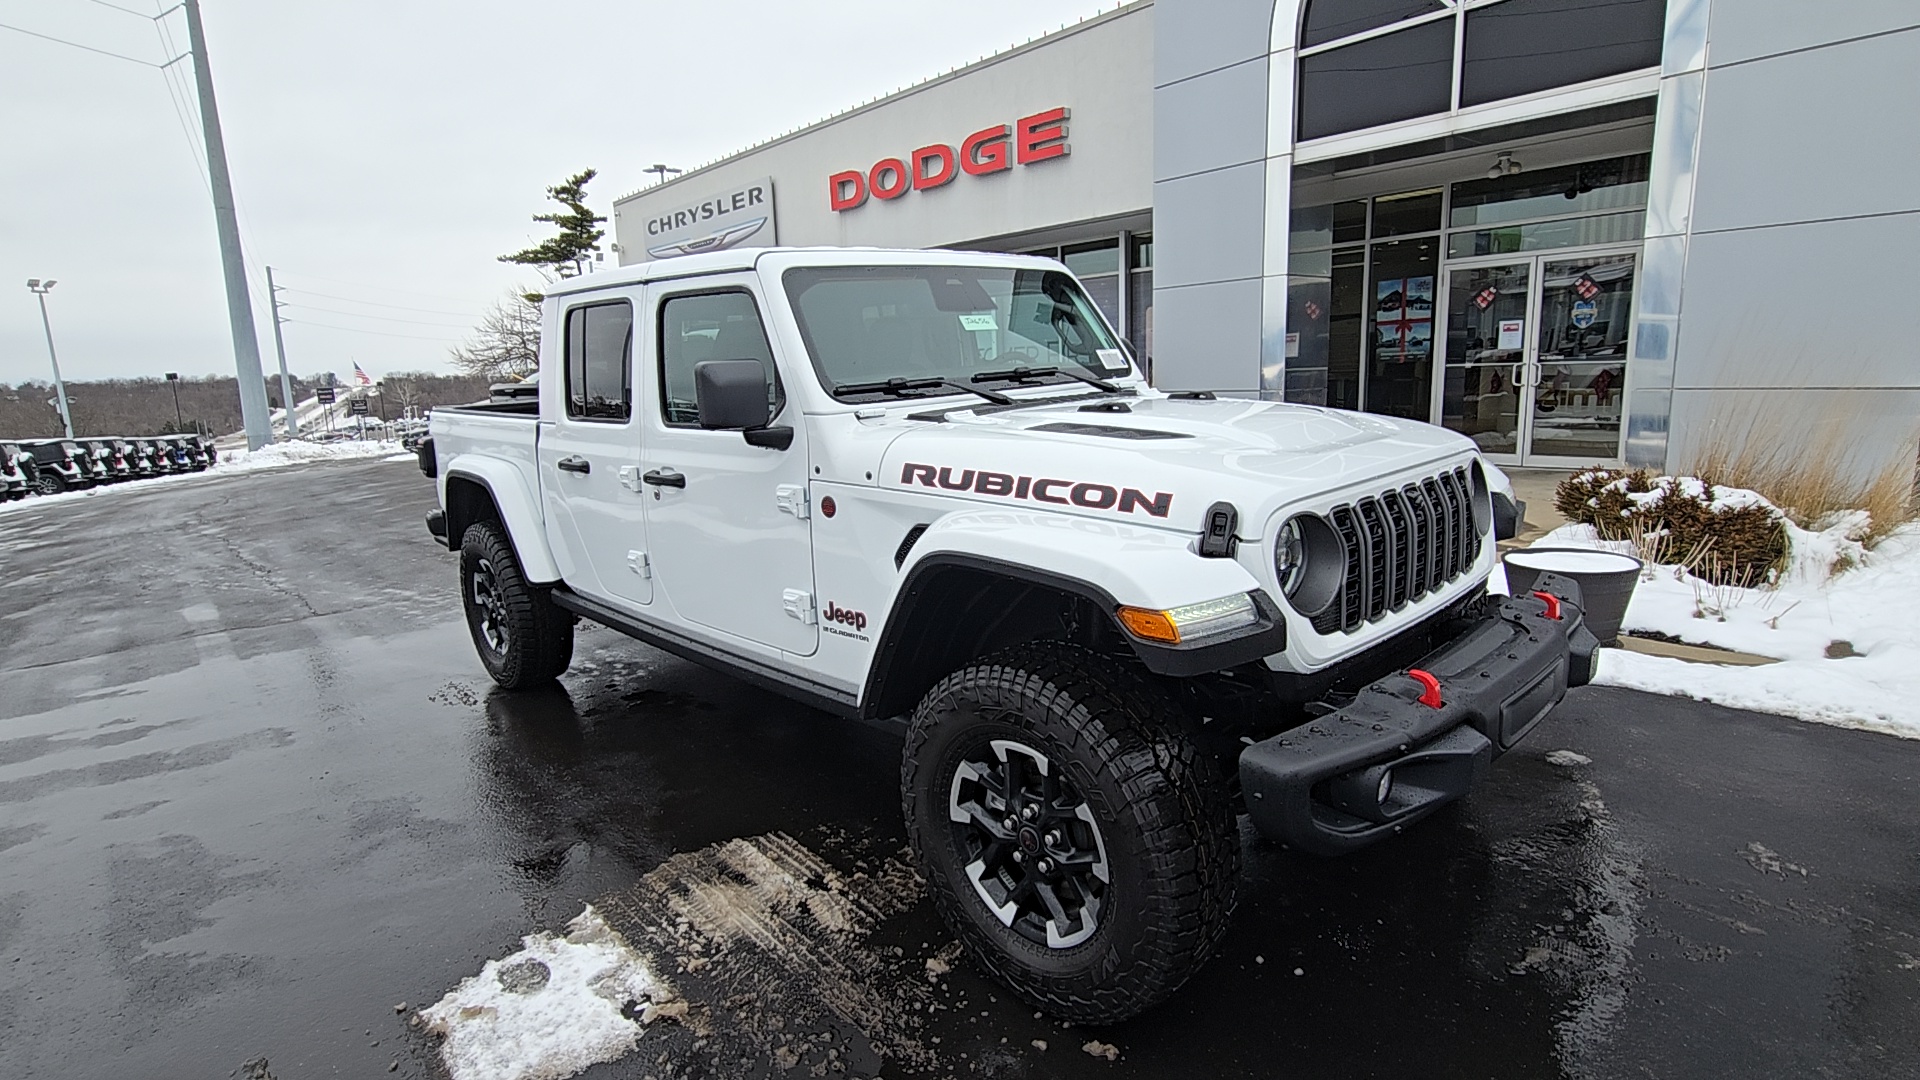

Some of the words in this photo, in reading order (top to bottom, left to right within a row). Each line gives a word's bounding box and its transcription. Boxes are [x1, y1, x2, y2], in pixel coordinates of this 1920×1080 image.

[829, 107, 1071, 212] DODGE
[647, 186, 763, 235] CHRYSLER
[901, 462, 1173, 518] RUBICON
[823, 601, 867, 632] Jeep
